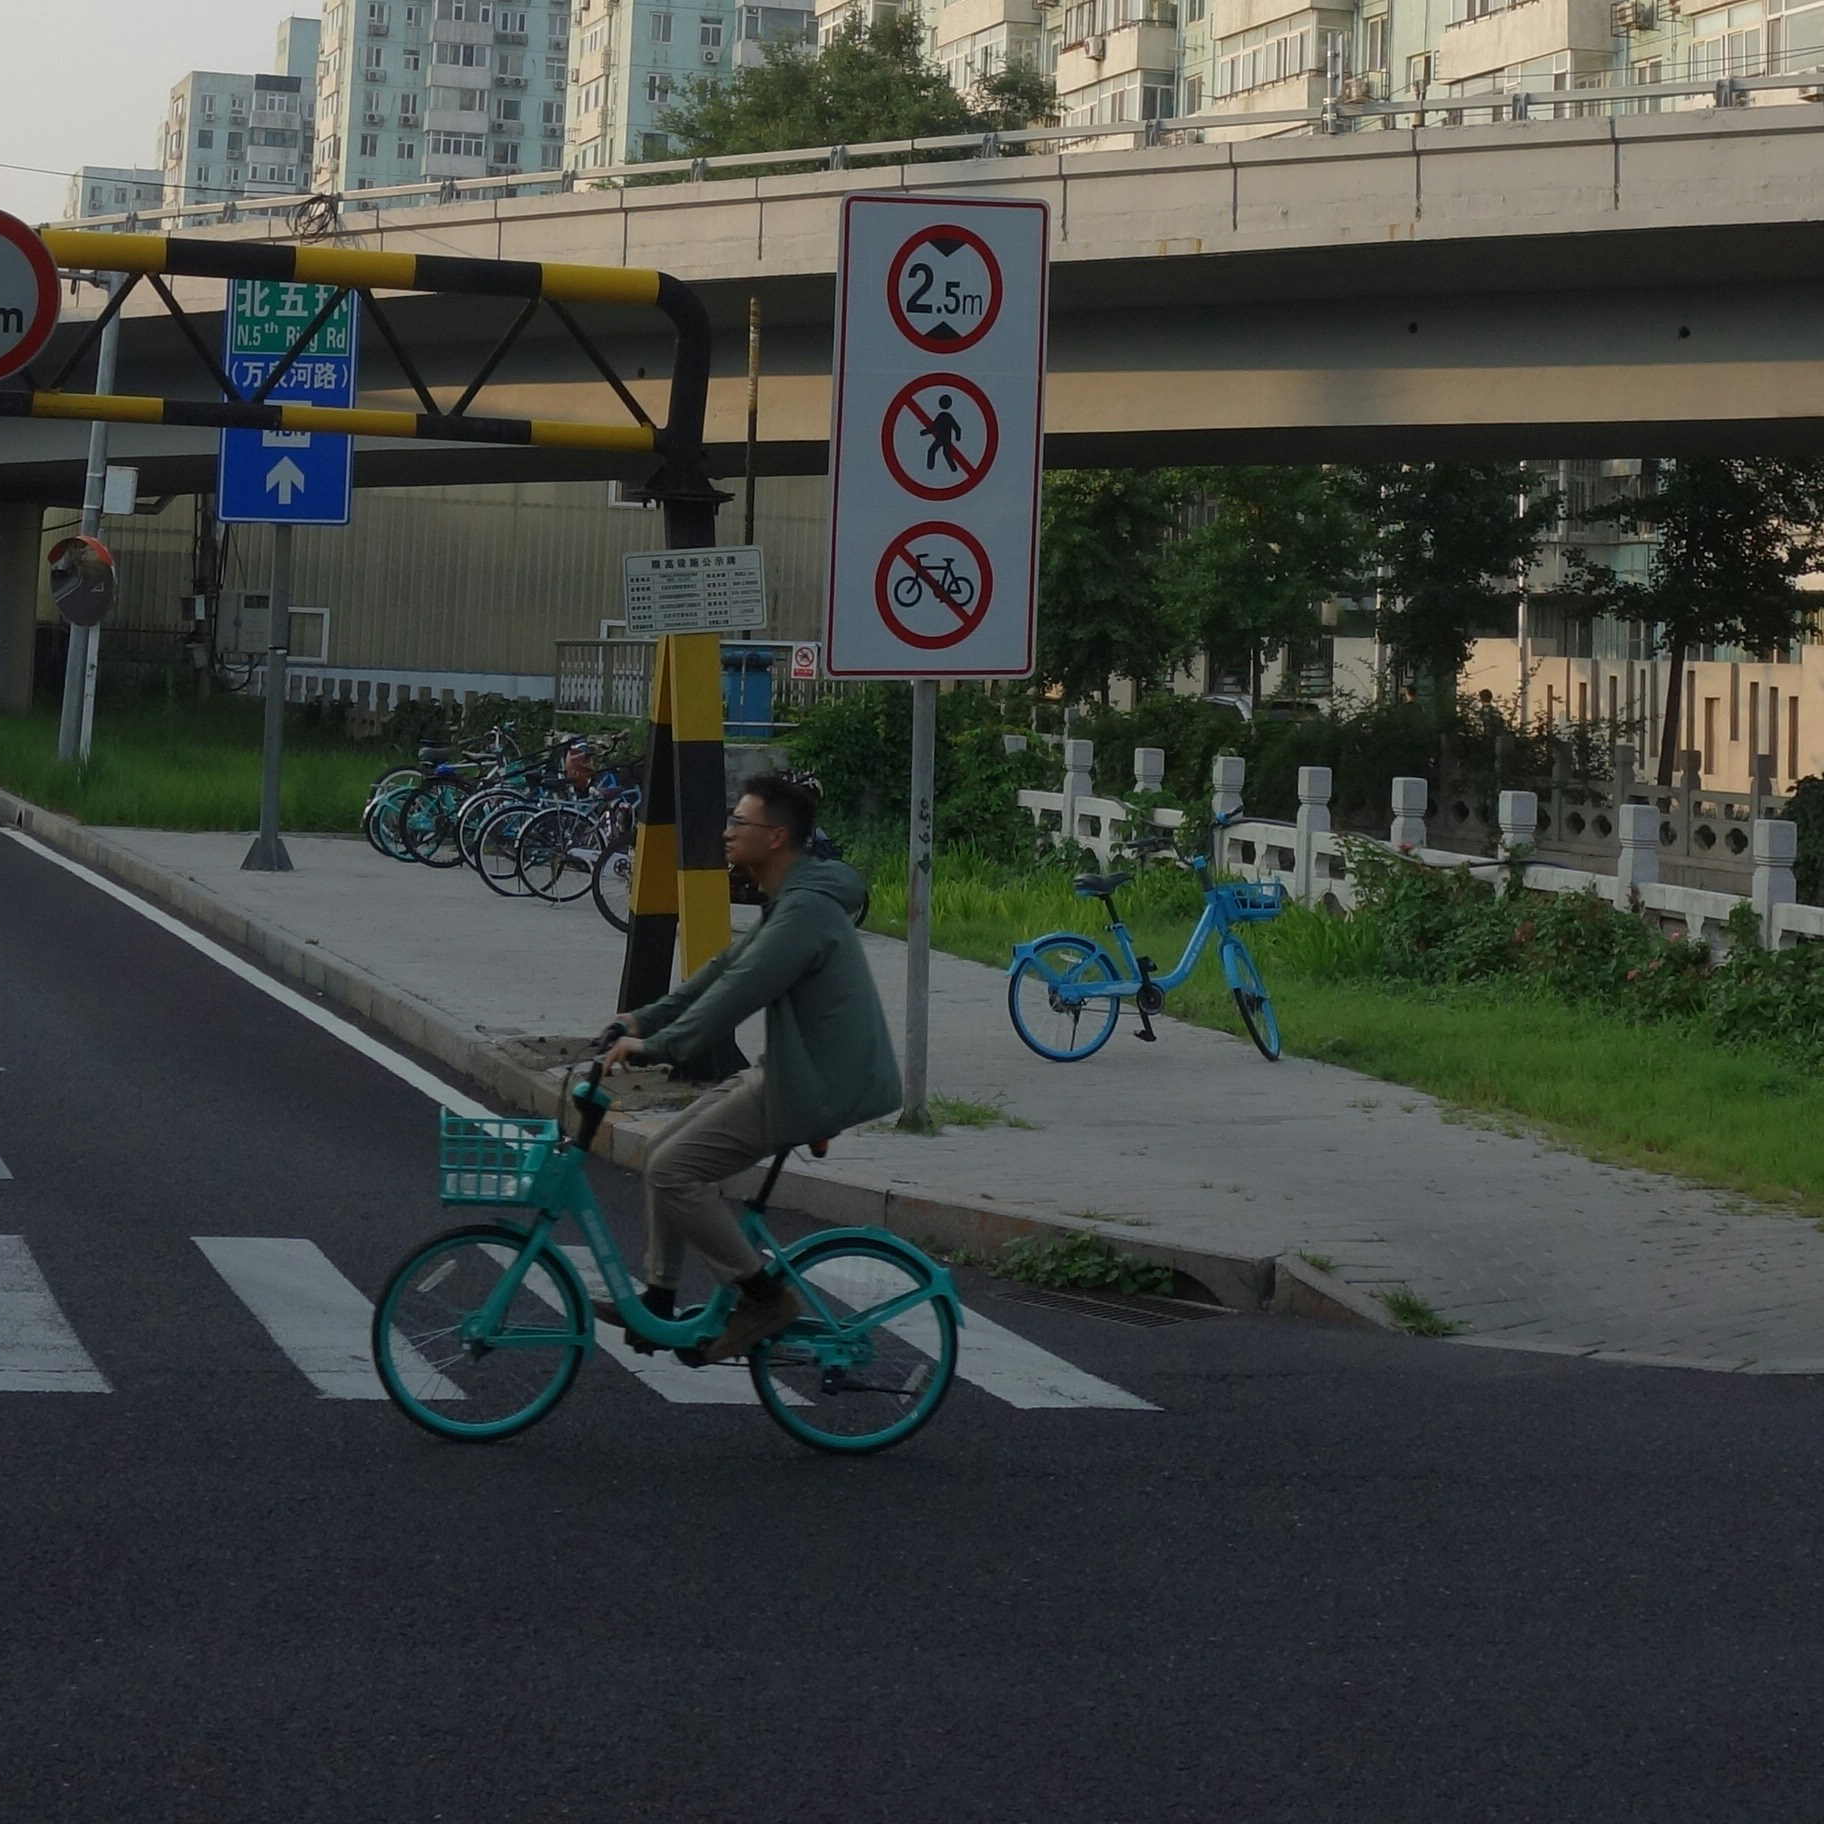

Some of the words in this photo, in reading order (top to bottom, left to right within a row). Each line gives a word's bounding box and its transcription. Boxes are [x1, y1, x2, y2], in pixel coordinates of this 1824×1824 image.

[906, 263, 982, 316] 2.5m
[286, 326, 319, 353] Rig
[326, 327, 346, 349] Rd
